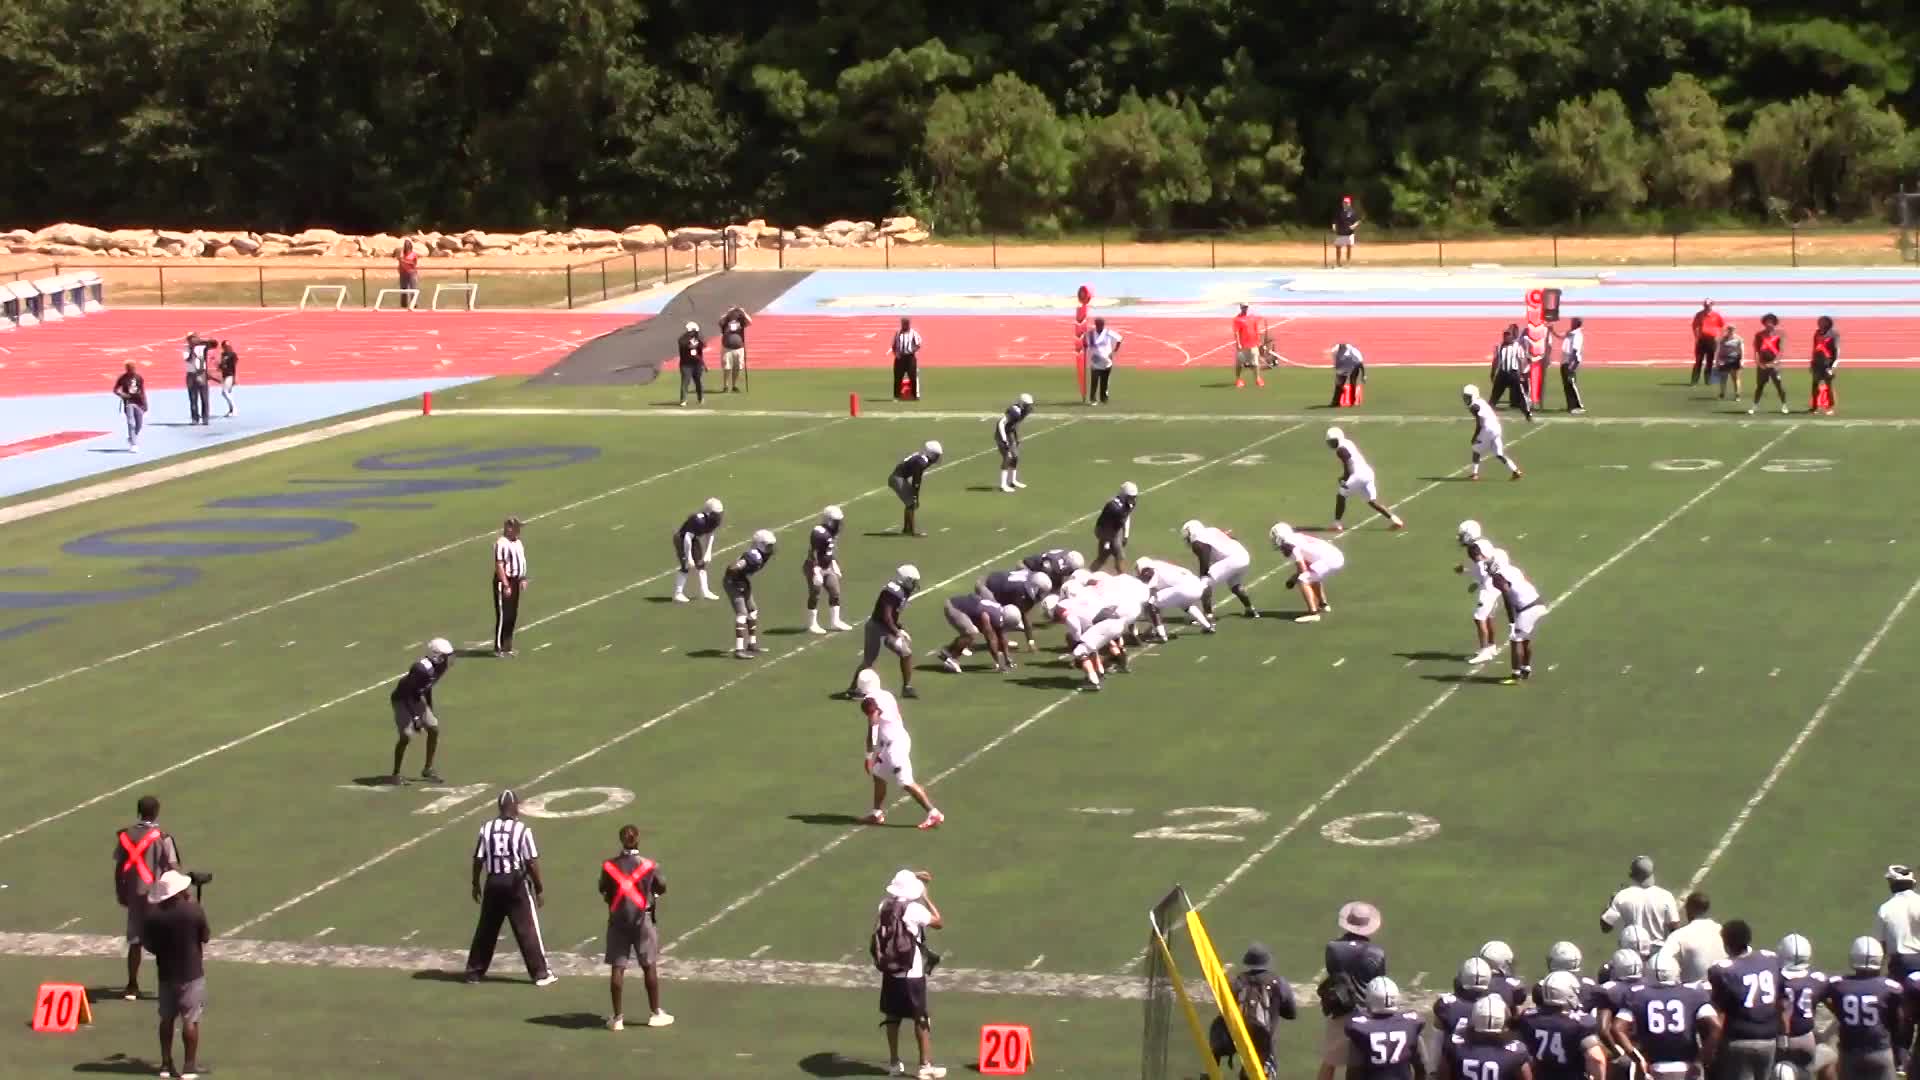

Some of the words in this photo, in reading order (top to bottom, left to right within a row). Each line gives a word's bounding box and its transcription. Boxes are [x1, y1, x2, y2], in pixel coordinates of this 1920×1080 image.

[493, 833, 510, 855] H
[1742, 970, 1775, 1008] 79
[41, 990, 73, 1027] 10
[1647, 999, 1685, 1034] 63
[1842, 995, 1879, 1026] 95
[984, 1029, 1021, 1069] 20
[1369, 1030, 1407, 1064] 57
[1534, 1029, 1567, 1064] 74
